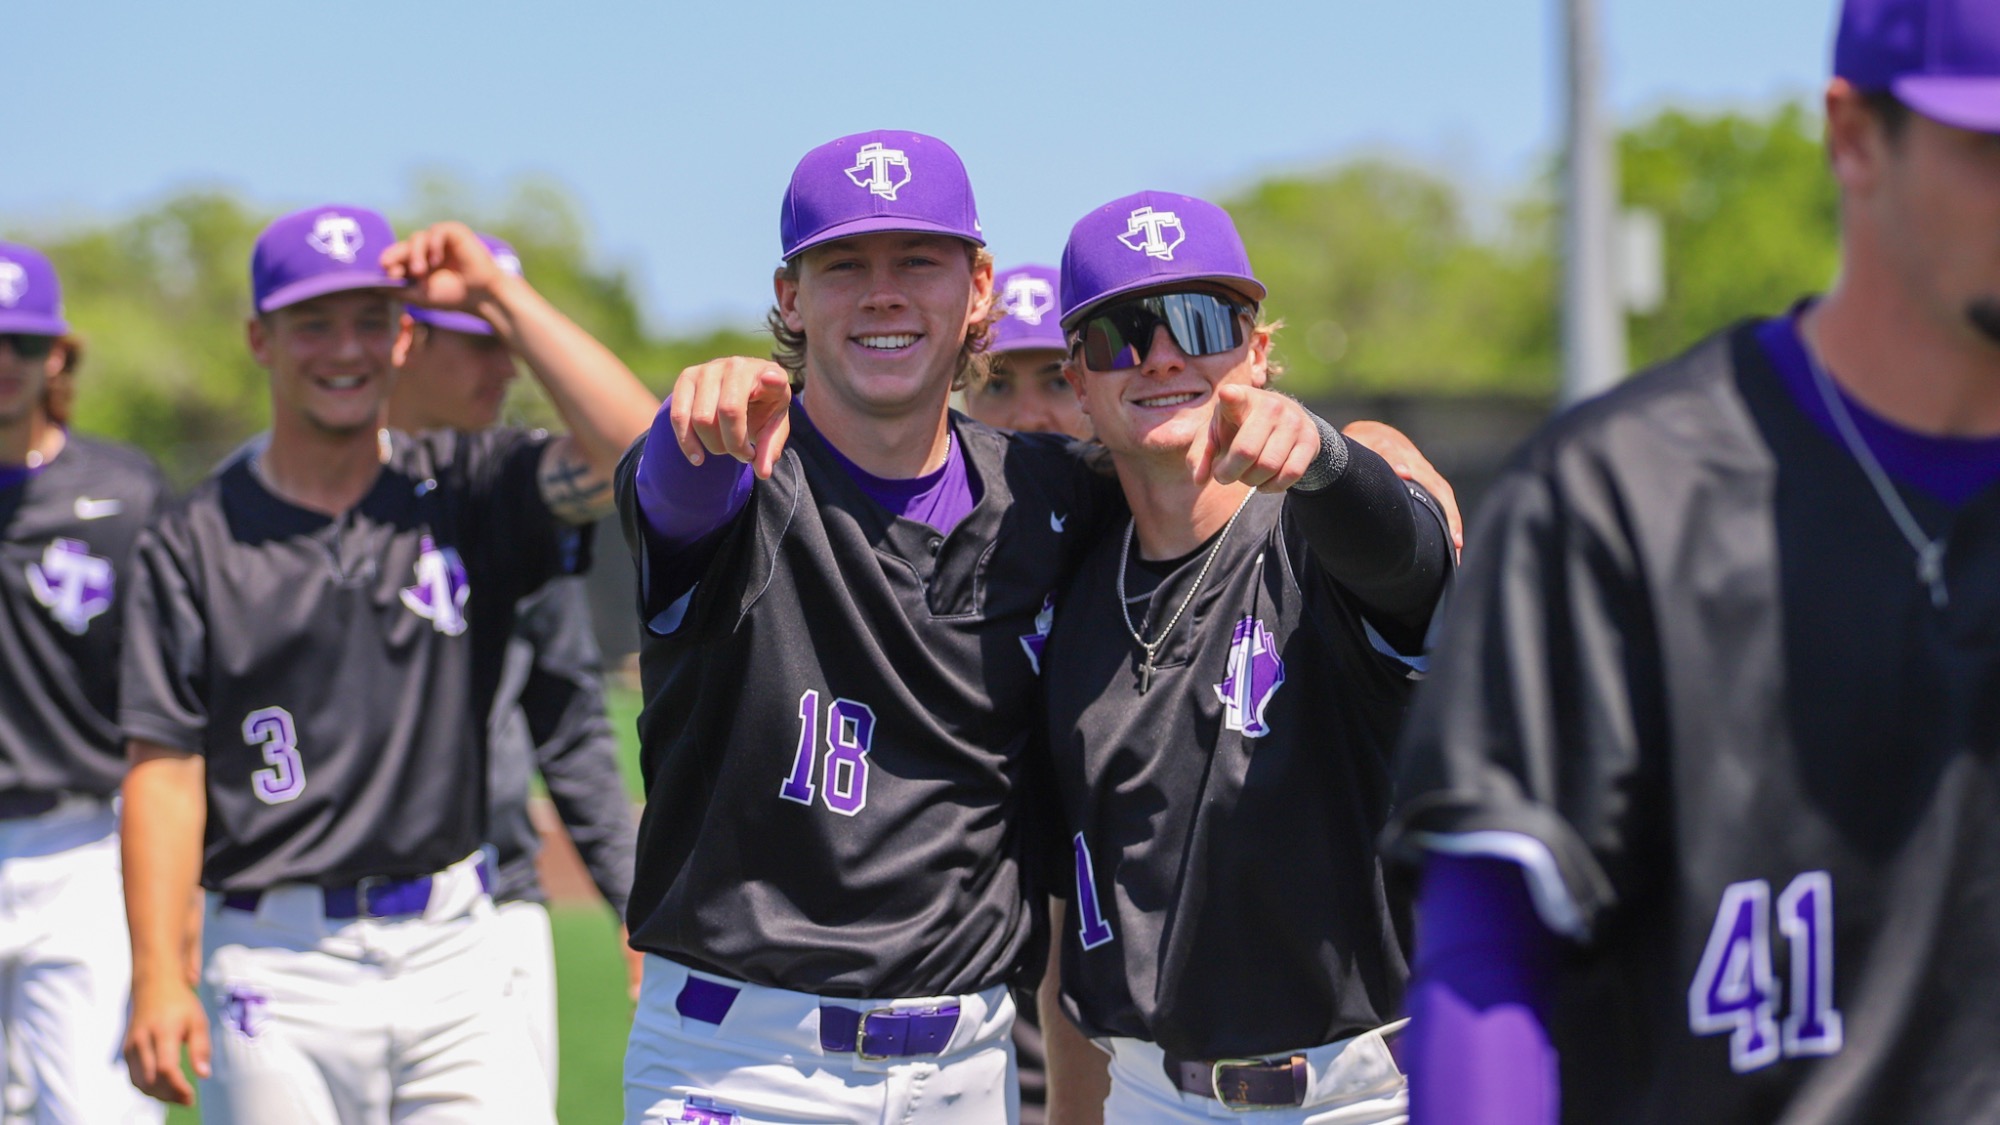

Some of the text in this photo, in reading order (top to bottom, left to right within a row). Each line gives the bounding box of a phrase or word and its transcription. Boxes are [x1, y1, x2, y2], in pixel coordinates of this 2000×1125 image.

[855, 148, 906, 194] T
[314, 216, 356, 259] T
[1127, 212, 1181, 257] T
[1004, 278, 1052, 321] T
[241, 705, 307, 805] 3
[778, 688, 877, 817] 18
[1687, 869, 1843, 1074] 41
